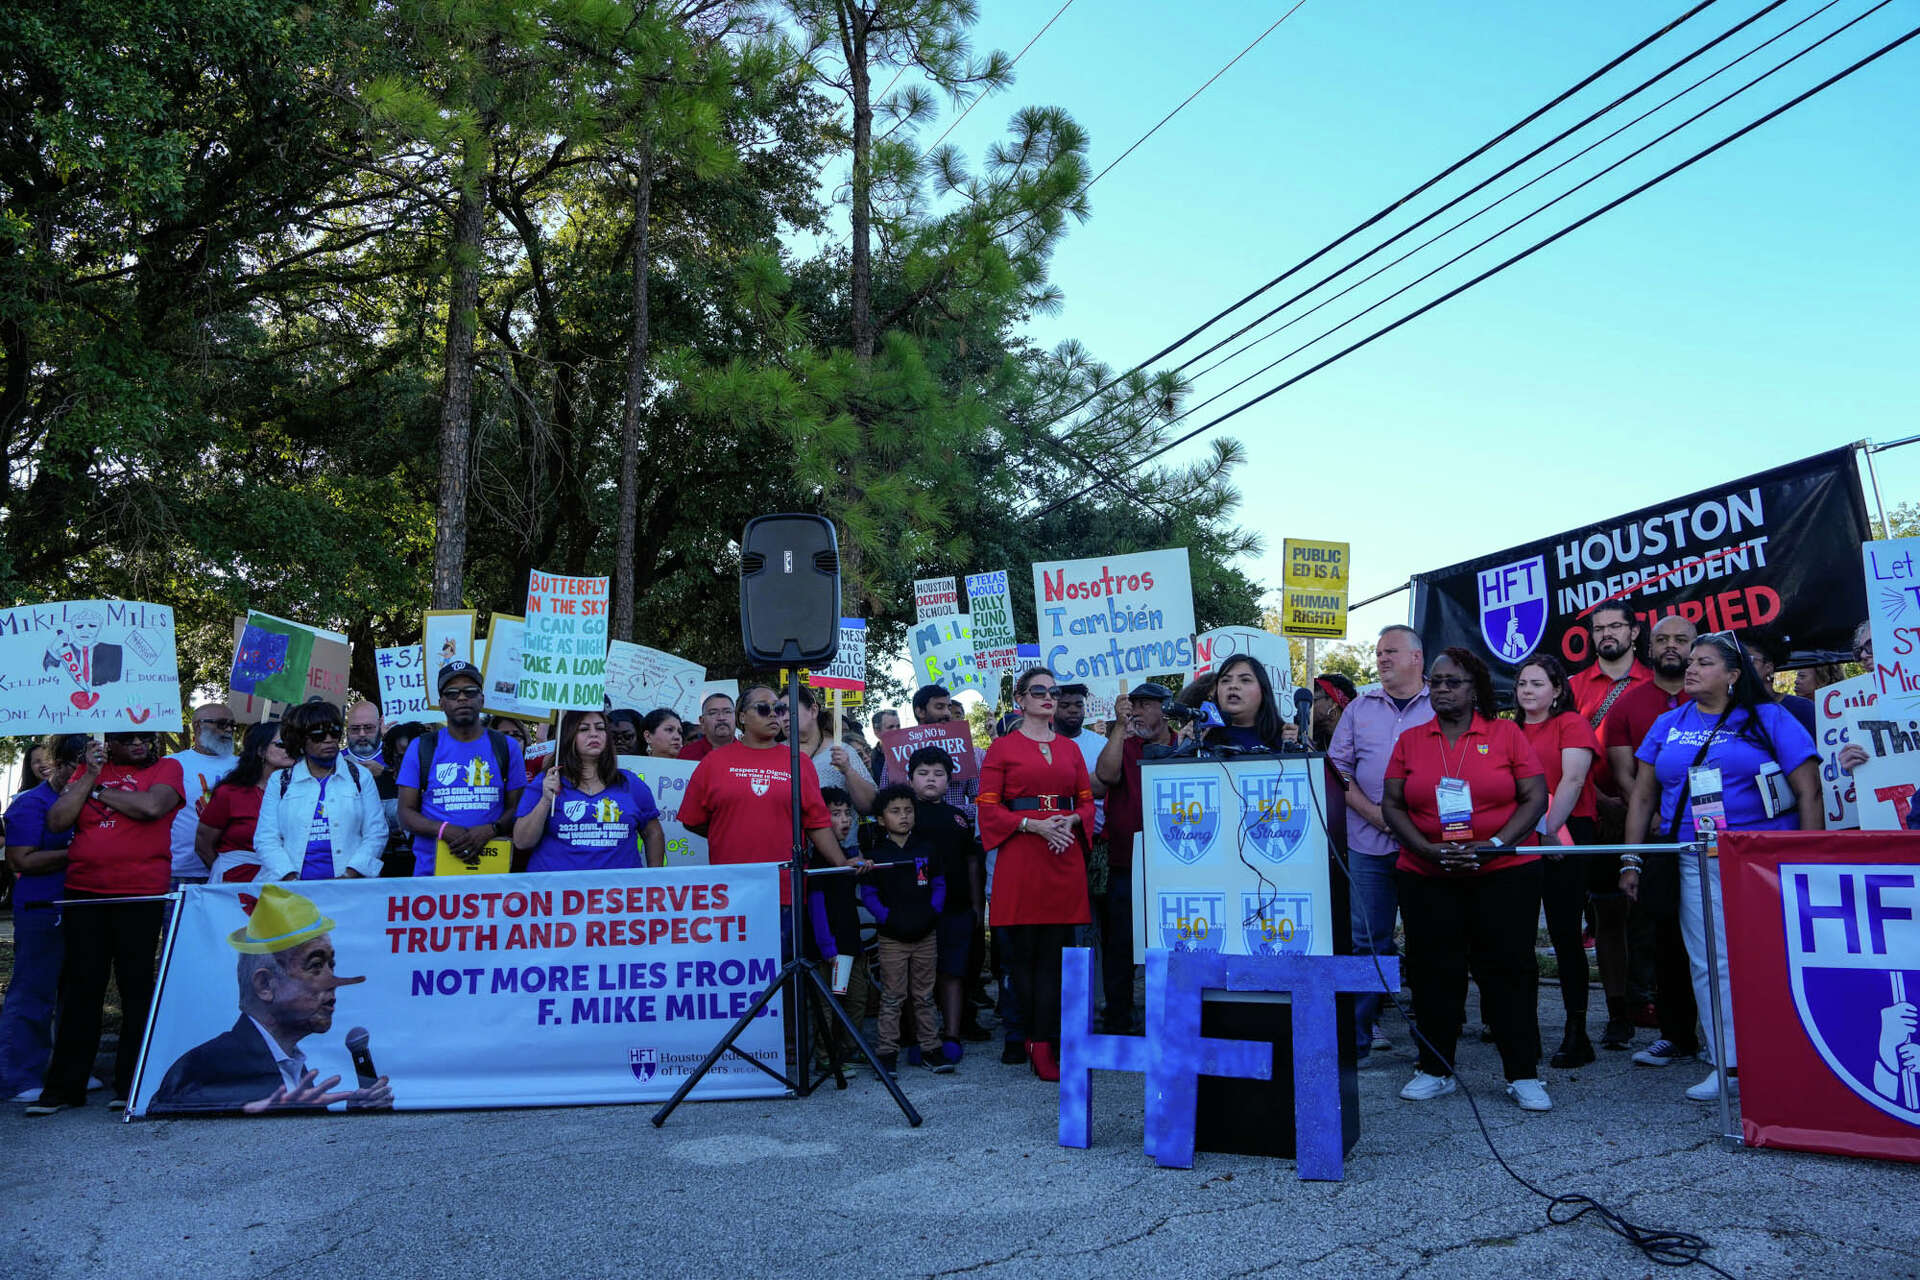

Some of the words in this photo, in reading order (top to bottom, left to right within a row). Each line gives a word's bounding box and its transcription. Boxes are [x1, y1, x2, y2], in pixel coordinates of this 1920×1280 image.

[1556, 487, 1764, 580] HOUSTON
[1292, 547, 1341, 563] PUBLIC
[1870, 551, 1913, 580] Let
[965, 577, 974, 587] IF
[976, 572, 1005, 585] TEXAS
[1292, 563, 1311, 577] ED
[1314, 564, 1328, 578] IS
[1331, 566, 1340, 579] A
[1557, 536, 1769, 616] INDEPENDENT
[530, 573, 607, 596] BUTTERFLY
[916, 580, 955, 594] HOUSTON
[968, 583, 1005, 597] WOULD
[1043, 565, 1154, 602] Nosotros
[1482, 560, 1538, 607] HFT
[527, 595, 541, 613] IN
[550, 598, 577, 615] THE
[581, 598, 608, 616] SKY
[916, 592, 957, 607] OCCUPIED
[971, 594, 1005, 613] FULLY
[1291, 594, 1340, 610] HUMAN
[919, 605, 955, 619] SCHOOL
[973, 610, 1007, 628] FUND
[1045, 597, 1164, 637] También
[1292, 610, 1336, 625] RIGHT!
[540, 617, 575, 635] CAN
[582, 619, 605, 634] GO
[840, 629, 865, 643] MESS
[916, 620, 972, 655] Mile
[972, 626, 1010, 640] PUBLIC
[523, 632, 553, 652] TWICE
[558, 638, 573, 655] AS
[576, 638, 604, 657] HIGH
[840, 643, 858, 652] XAS
[973, 636, 1017, 651] EDUCATION
[522, 653, 552, 674] TAKE
[556, 657, 567, 674] A
[573, 658, 606, 676] LOOK
[832, 652, 862, 665] LIC
[975, 651, 987, 660] WE
[976, 659, 988, 669] BE
[991, 657, 1016, 669] HERE!
[1047, 633, 1198, 682] Contamos!
[518, 679, 540, 700] IT'S
[541, 682, 557, 702] IN
[559, 683, 569, 704] A
[573, 683, 605, 705] BOOK
[90, 708, 107, 719] AT
[909, 731, 923, 741] Say
[925, 728, 937, 738] NO
[938, 728, 946, 736] to
[1156, 781, 1217, 809] HFT
[1243, 778, 1306, 808] HFT
[1171, 801, 1202, 824] 50
[1259, 798, 1291, 822] 50
[1163, 826, 1213, 845] Strong
[1250, 823, 1301, 843] Strong
[387, 890, 553, 921] HOUSTON
[562, 883, 730, 916] DESERVES
[1162, 896, 1221, 928] HFT
[1244, 897, 1309, 929] HFT
[1794, 873, 1915, 955] HF
[386, 925, 498, 954] TRUTH
[505, 922, 577, 951] AND
[585, 915, 746, 947] RESPECT!
[1176, 917, 1208, 940] 50
[1261, 918, 1293, 942] 50
[411, 968, 485, 996] NOT
[491, 965, 590, 994] MORE
[598, 962, 667, 990] LIES
[676, 958, 777, 988] FROM
[537, 998, 562, 1025] F.
[571, 996, 657, 1024] MIKE
[665, 991, 778, 1020] MILES.
[630, 1049, 653, 1061] HFT
[660, 1050, 709, 1063] Housto
[1059, 947, 1400, 1181] HFT
